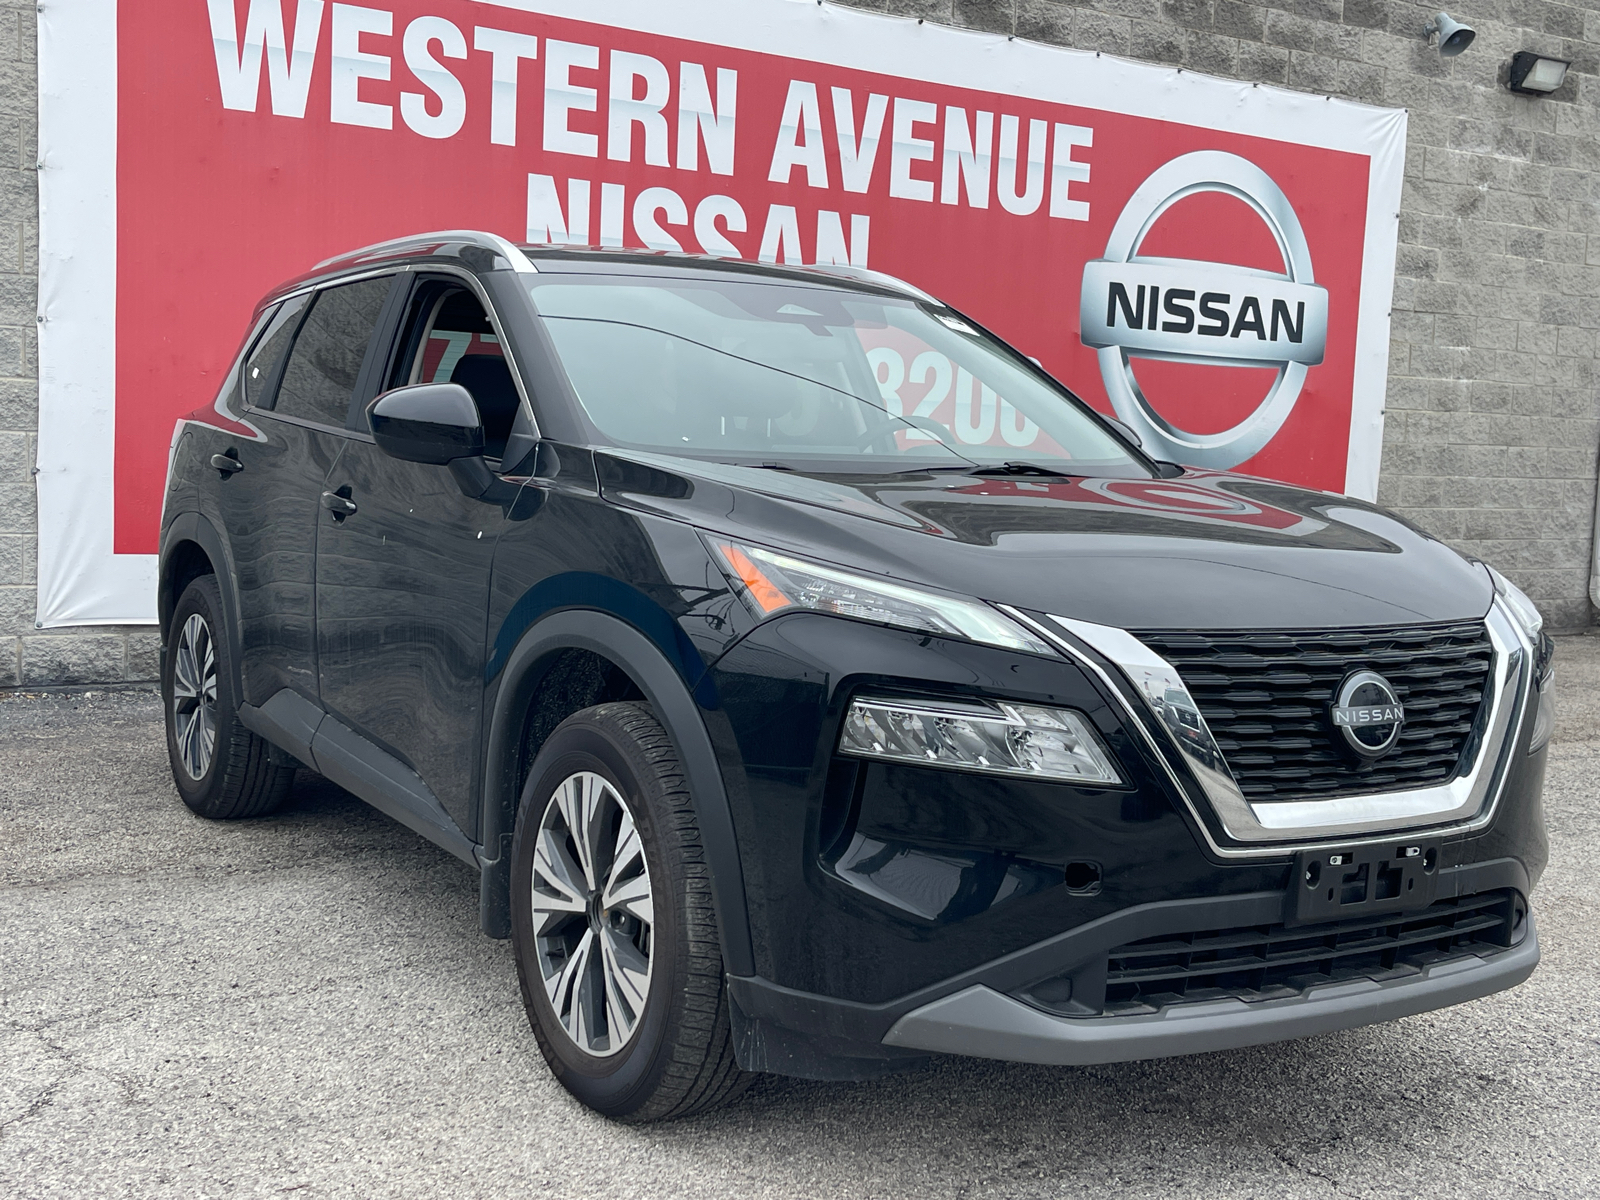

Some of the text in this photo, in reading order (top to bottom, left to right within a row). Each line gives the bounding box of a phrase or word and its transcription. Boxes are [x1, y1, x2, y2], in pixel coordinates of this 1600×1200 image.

[207, 0, 1094, 222] WESTERN AVENUE
[526, 172, 870, 268] NISSAN
[1106, 281, 1305, 344] NISSAN
[1335, 707, 1404, 723] NISSAN
